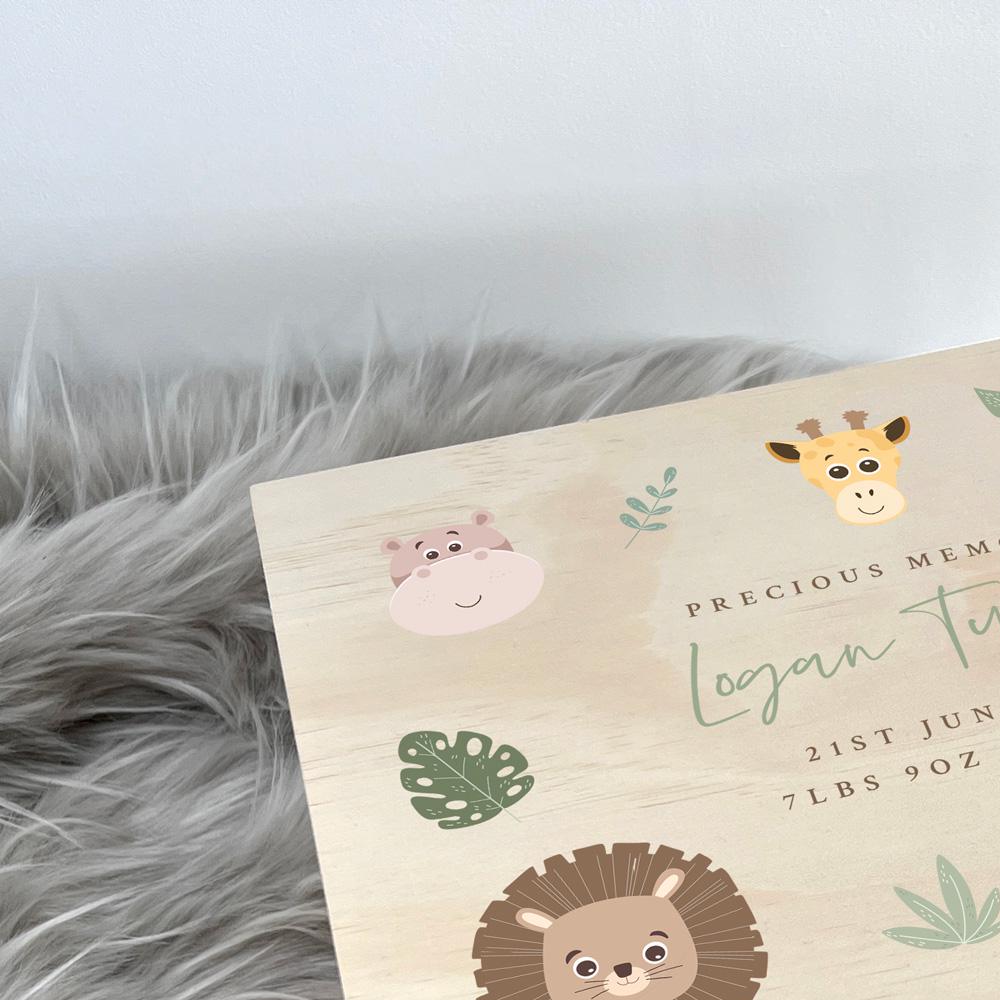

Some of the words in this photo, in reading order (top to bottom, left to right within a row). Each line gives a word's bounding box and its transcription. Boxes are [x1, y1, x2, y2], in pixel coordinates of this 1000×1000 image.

[685, 563, 884, 618] PRECIOUS
[689, 639, 896, 727] Logan
[805, 727, 895, 763] 21ST
[782, 774, 881, 811] 7LBS
[904, 750, 980, 783] 9OZ
